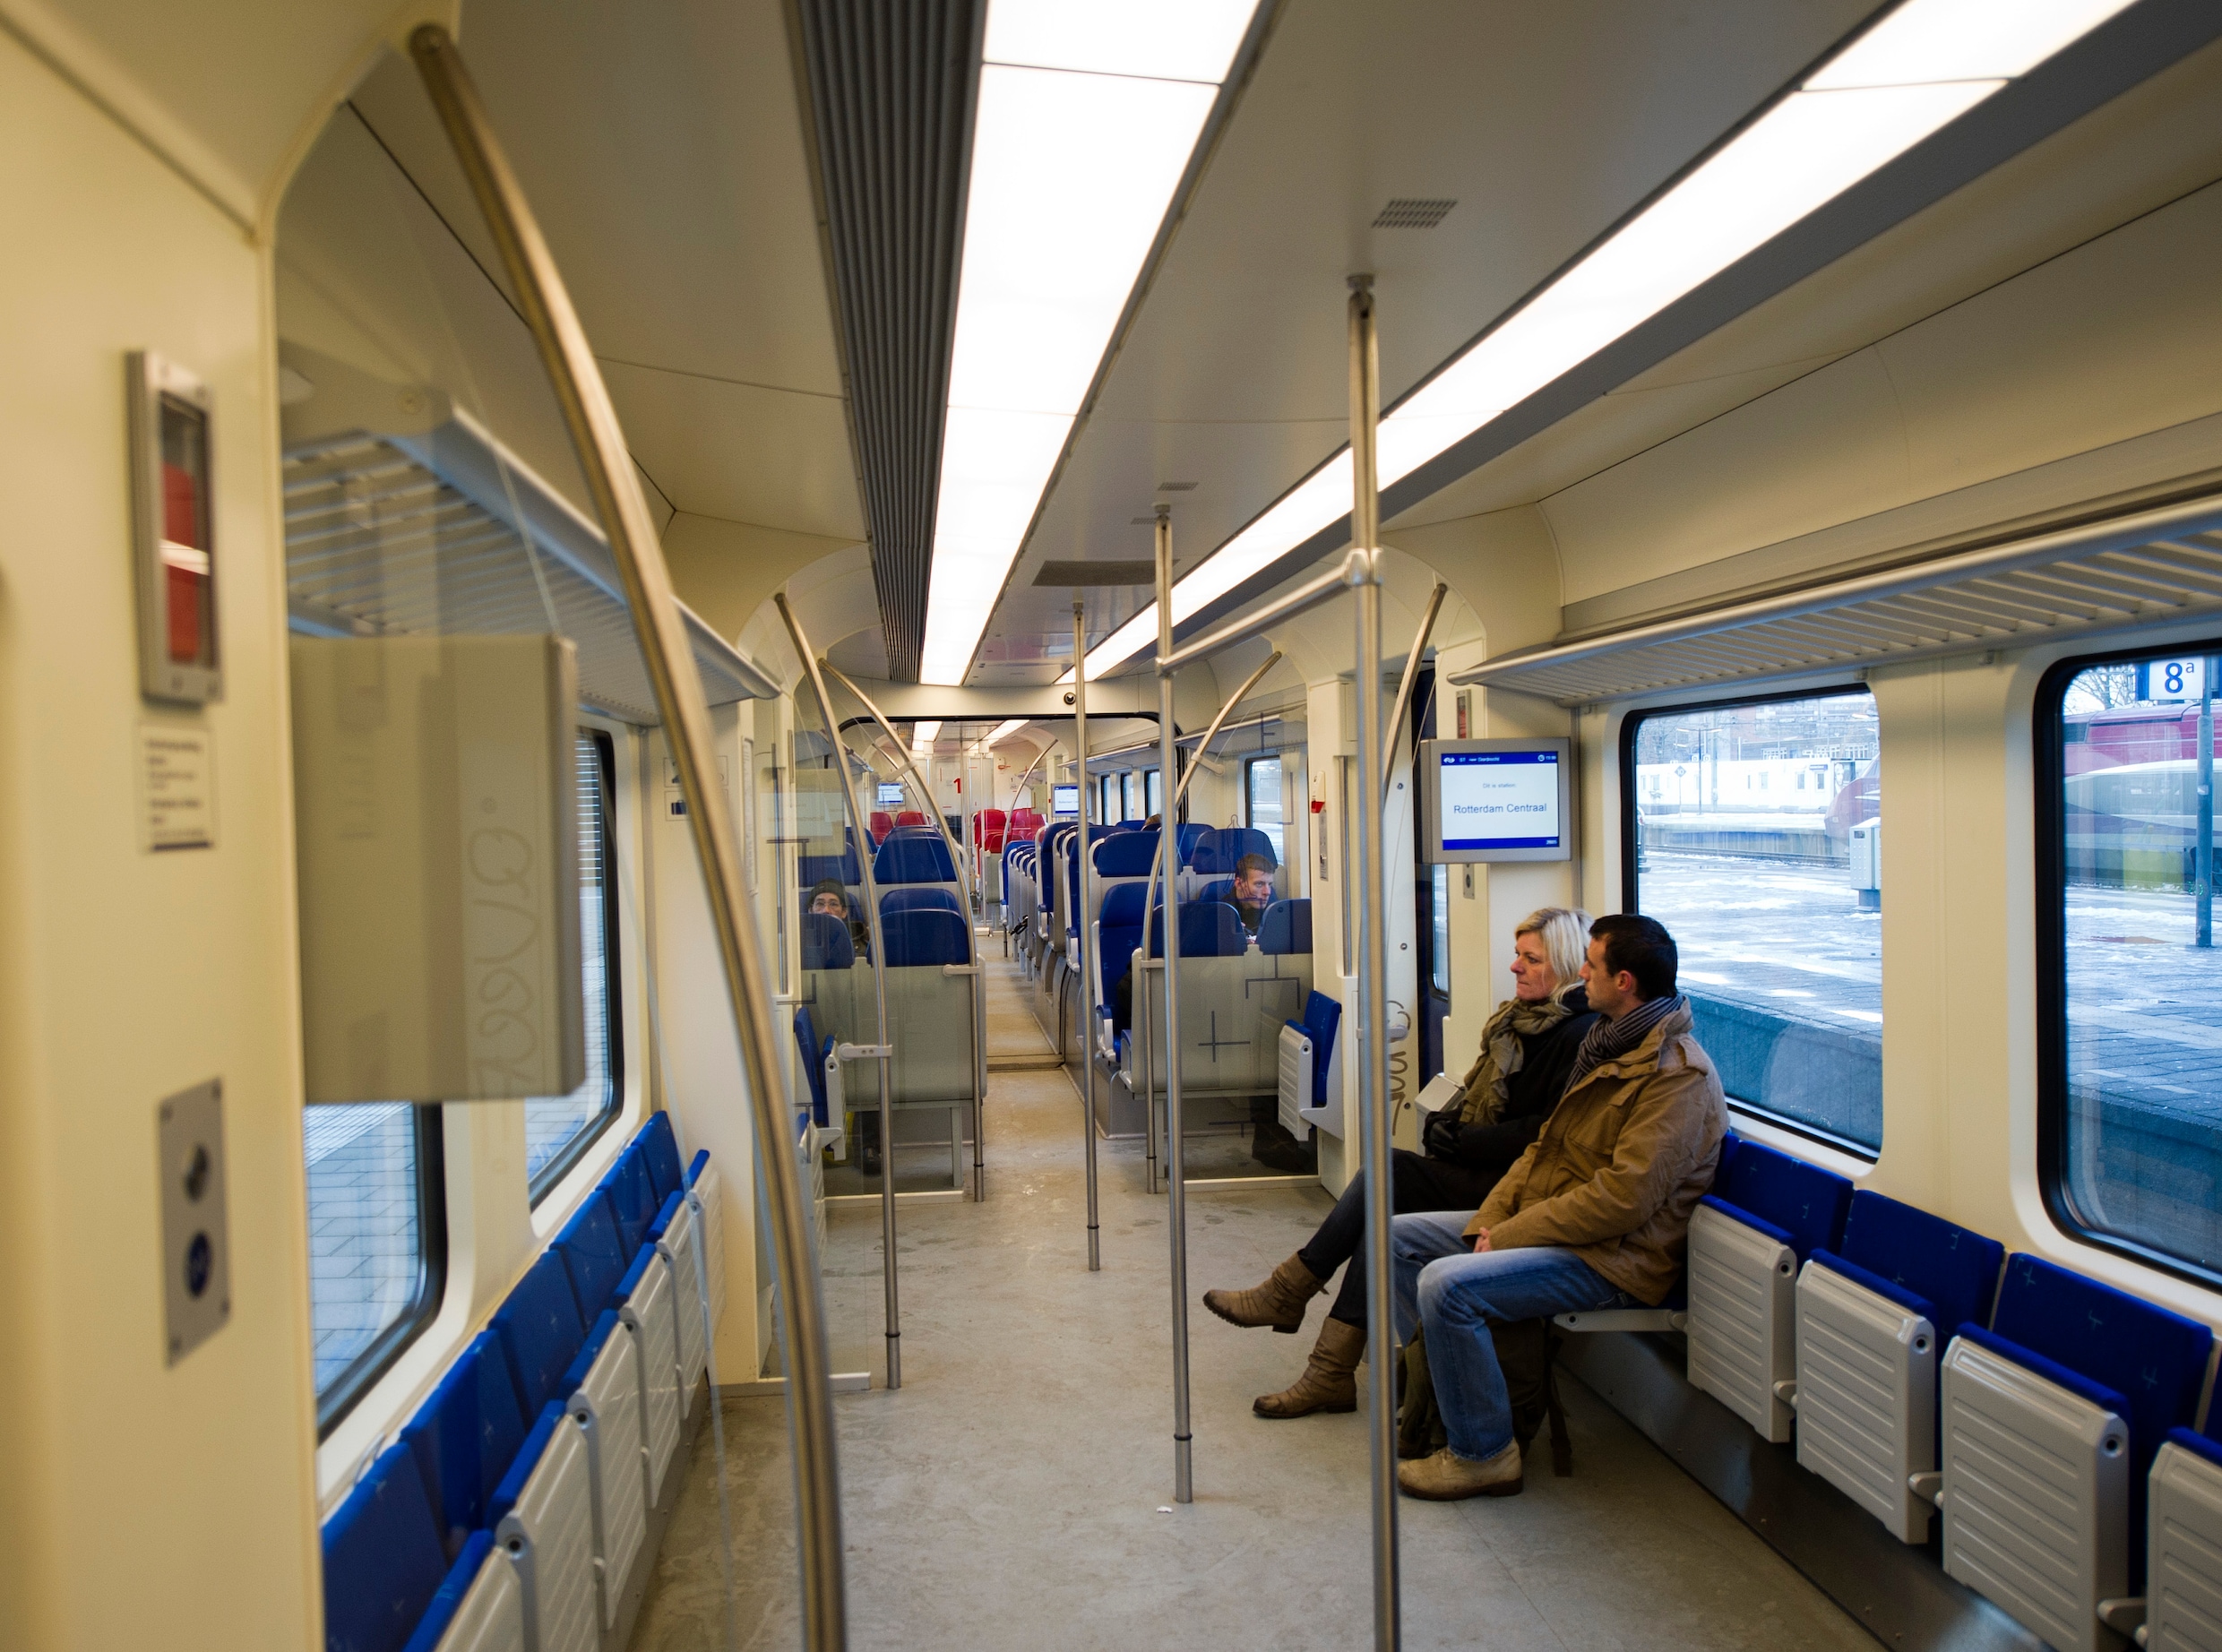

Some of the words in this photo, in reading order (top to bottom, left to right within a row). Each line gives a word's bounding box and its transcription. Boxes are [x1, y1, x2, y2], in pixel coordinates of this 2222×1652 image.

[953, 778, 961, 794] 1
[1454, 804, 1503, 813] Rotterdam
[1506, 804, 1546, 813] Centraal
